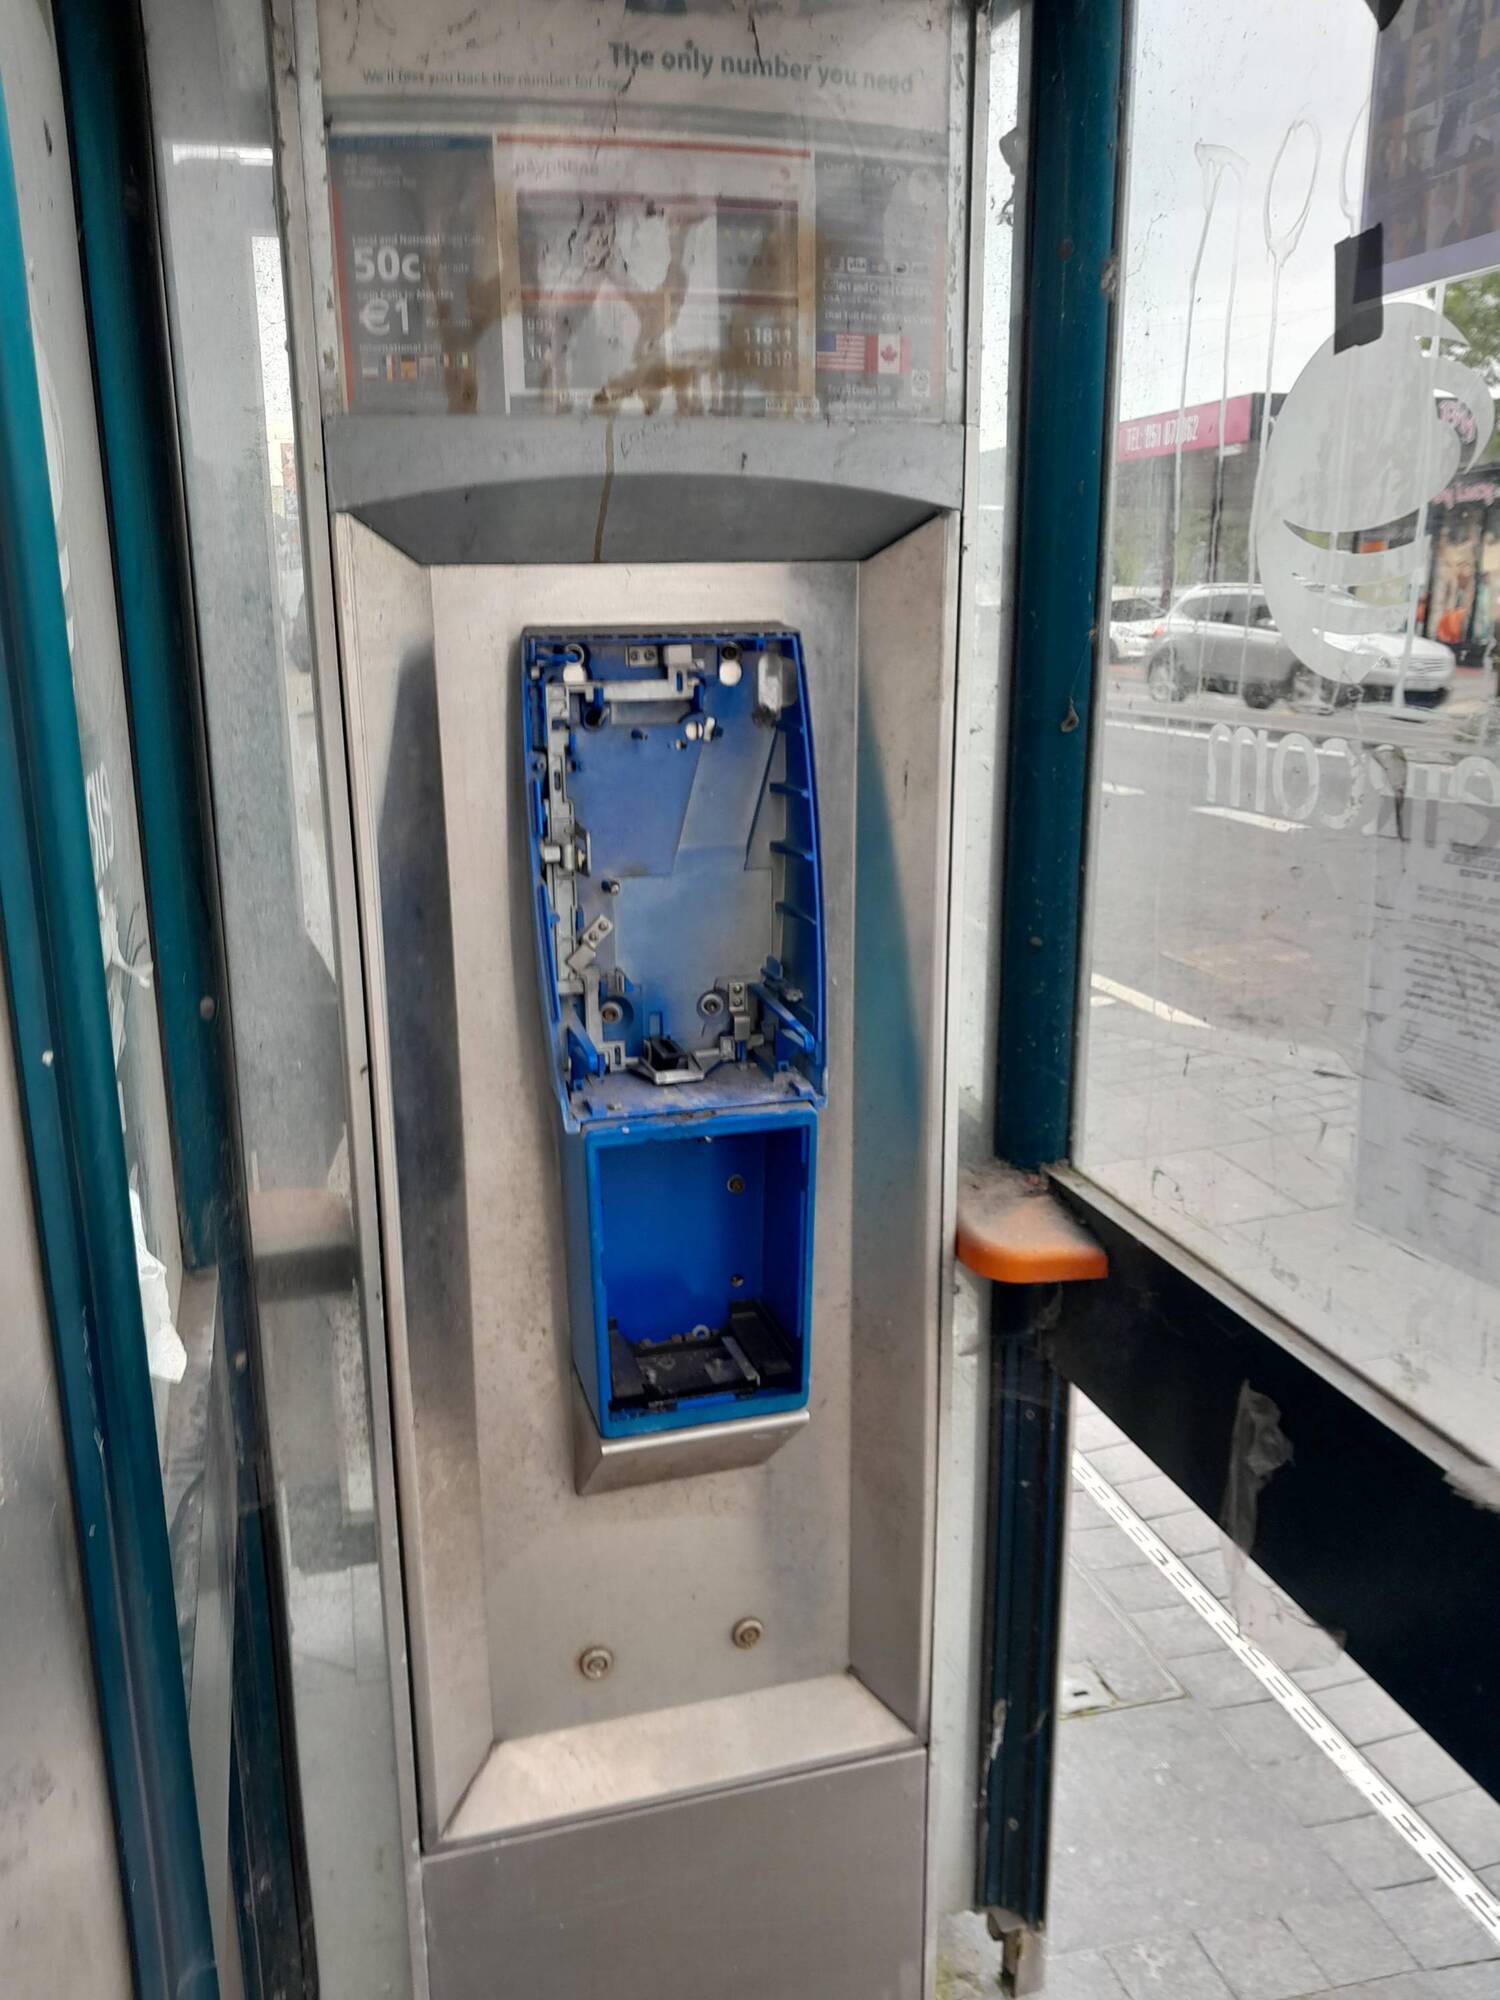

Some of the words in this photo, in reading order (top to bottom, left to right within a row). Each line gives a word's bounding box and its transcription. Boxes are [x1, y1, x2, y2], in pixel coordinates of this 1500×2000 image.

[608, 41, 654, 68] The
[662, 46, 714, 78] only
[721, 53, 812, 81] number
[818, 63, 857, 88] you
[863, 70, 914, 95] need
[353, 245, 421, 283] 50c
[358, 294, 410, 337] €1
